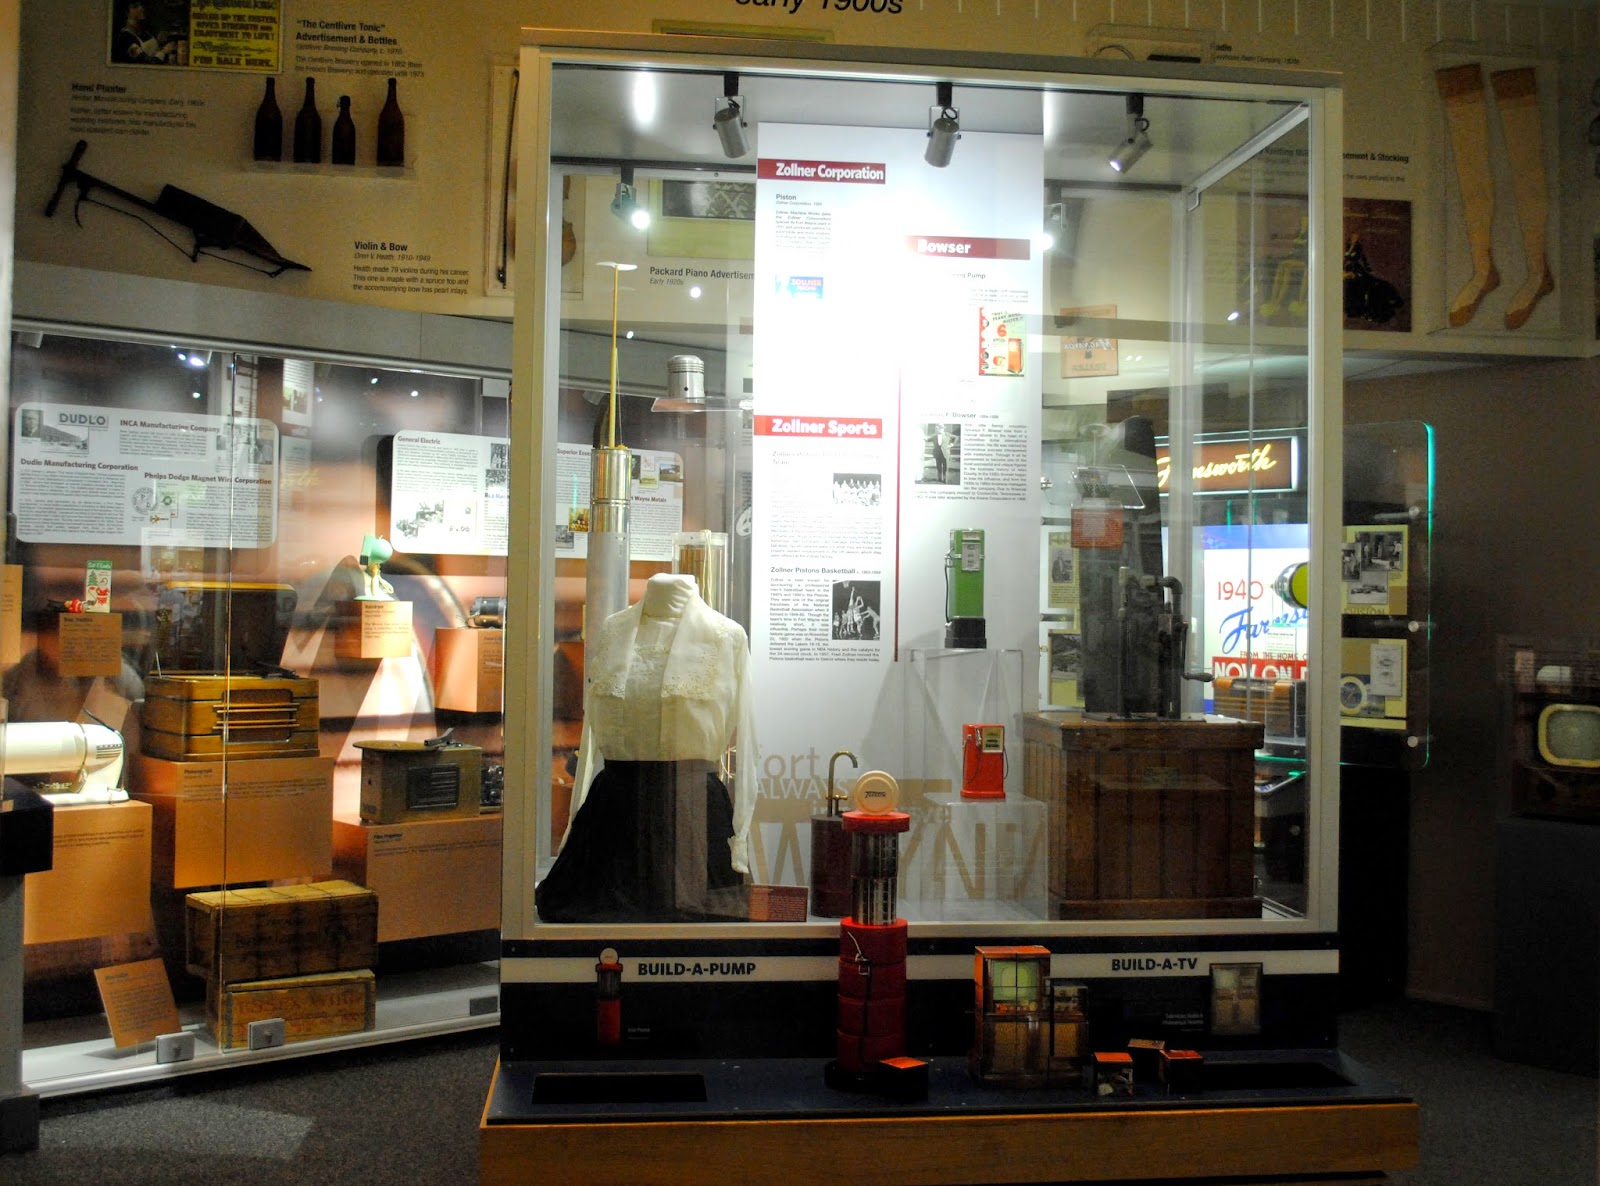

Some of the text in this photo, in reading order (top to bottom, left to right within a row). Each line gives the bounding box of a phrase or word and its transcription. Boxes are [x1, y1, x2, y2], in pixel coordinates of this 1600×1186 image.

[319, 21, 356, 30] Centlivre
[296, 32, 398, 45] Advertisement & Bottles
[194, 56, 213, 65] FOR
[217, 57, 242, 66] SALE
[1370, 152, 1376, 160] &
[1377, 153, 1409, 164] Stocking
[776, 163, 885, 181] Zollner Corporation
[776, 193, 797, 201] Piston
[355, 241, 408, 252] Violin & Bow
[917, 238, 972, 255] Bowser
[420, 268, 438, 276] during
[650, 266, 755, 280] Packard Piano Advertisem
[967, 272, 987, 280] Pump
[386, 276, 404, 284] maple
[426, 278, 445, 286] spruce
[447, 278, 456, 286] top
[650, 277, 665, 286] Early
[364, 285, 406, 294] accompanying
[434, 286, 449, 295] pearl
[996, 323, 1008, 338] 6
[59, 412, 107, 426] DUDLO
[120, 419, 220, 434] INCA Manufacturing Company
[772, 417, 878, 437] Zollner Sports
[398, 435, 441, 445] General Electric
[557, 448, 578, 456] Superior
[20, 457, 139, 472] Dudlo Manufacturing Corporation
[144, 472, 167, 482] Phelps
[168, 473, 190, 483] Dodge
[191, 475, 216, 484] Magnet
[234, 477, 272, 487] Corporation
[821, 567, 856, 575] Basketball
[1217, 578, 1264, 601] 1940
[1262, 664, 1293, 680] ON
[763, 747, 819, 779] ort
[637, 962, 757, 977] BUILD-A-PUMP
[1111, 957, 1198, 972] BUILD-A-TV
